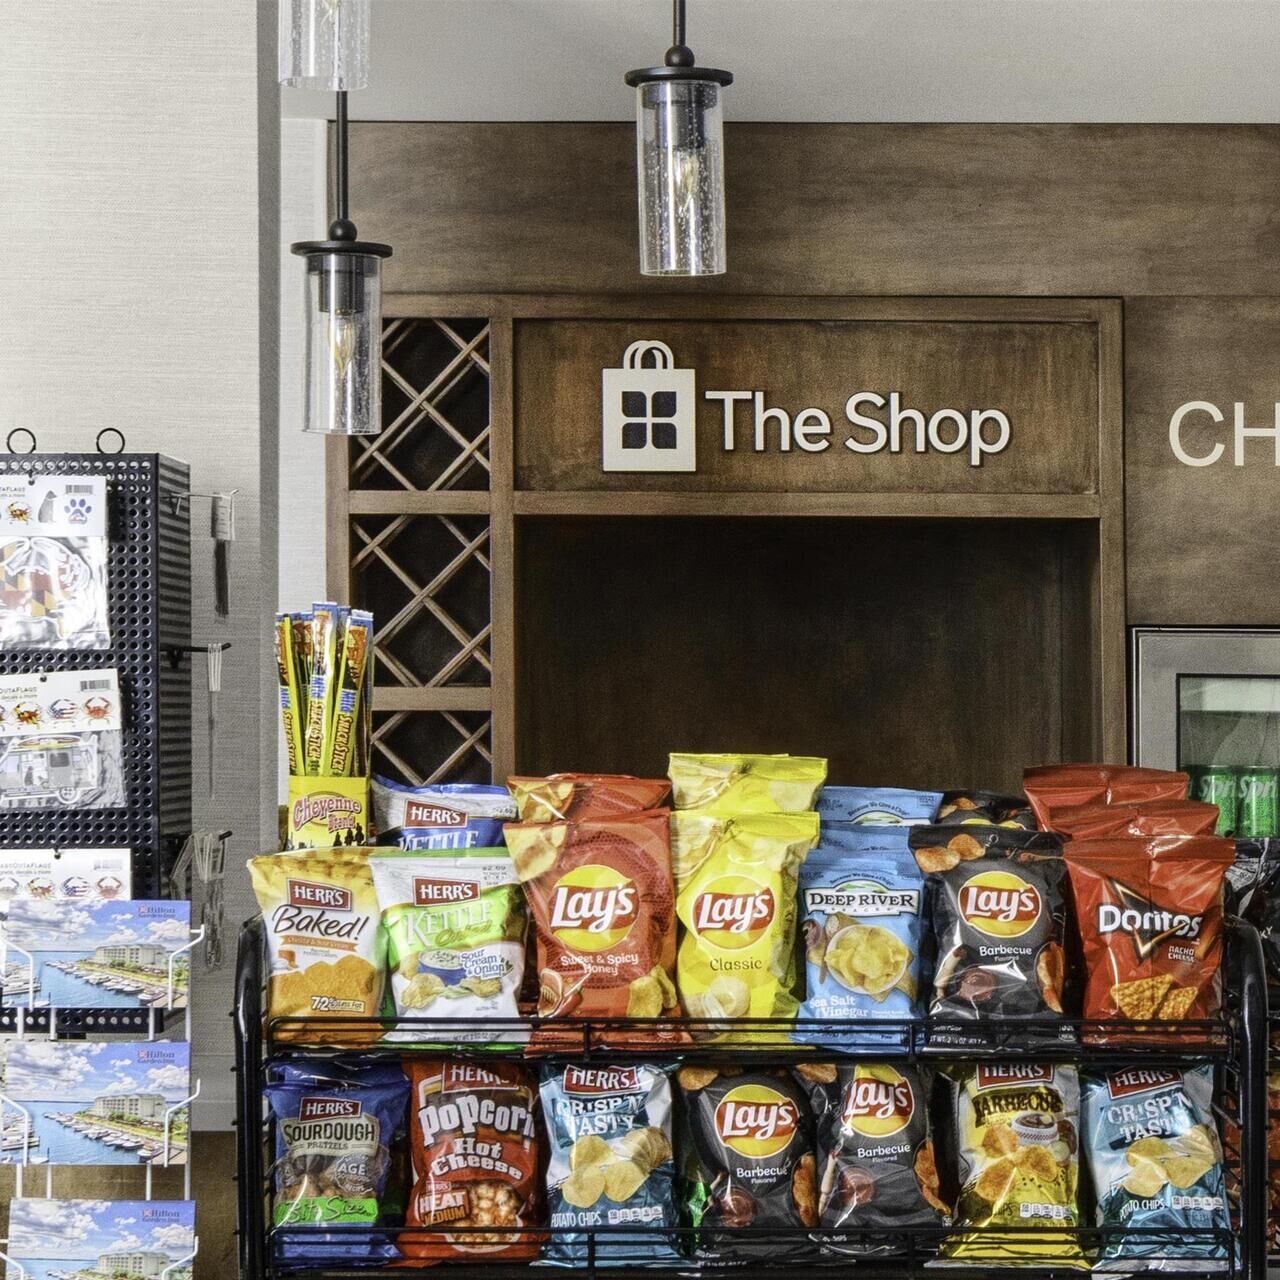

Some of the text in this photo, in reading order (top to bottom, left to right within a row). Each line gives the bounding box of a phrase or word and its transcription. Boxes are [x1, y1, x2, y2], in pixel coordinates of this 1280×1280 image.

[705, 390, 1012, 467] The Shop
[340, 690, 357, 713] Mild
[293, 793, 361, 829] Cheyenne
[411, 806, 461, 825] HERR'S
[293, 884, 344, 906] HERR'S
[420, 884, 474, 904] HERR'S
[809, 893, 915, 907] DEEP RIVER
[551, 883, 636, 933] Lay's
[697, 889, 770, 933] Lay's
[965, 886, 1035, 923] Lay's
[271, 904, 370, 940] Baked!
[405, 900, 493, 946] KETTLE
[1098, 904, 1204, 937] Doritos
[461, 949, 485, 962] Sour
[560, 952, 640, 968] Sweet & Spicy
[979, 945, 1033, 957] Barbecue
[464, 954, 498, 969] Cream
[474, 961, 505, 976] Onion
[584, 963, 619, 977] Honey
[709, 956, 763, 972] Classic
[821, 1004, 869, 1018] Vinegar
[830, 995, 856, 1007] Salt
[570, 1069, 631, 1089] HERR'S
[305, 1101, 354, 1116] HERR'S
[843, 1082, 908, 1119] Lay's
[722, 1098, 793, 1140] Lay's
[283, 1122, 376, 1144] SOURDOUGH
[307, 1142, 349, 1150] PRETZELS
[454, 1137, 502, 1159] Hot
[856, 1144, 911, 1158] Barbecue
[431, 1153, 523, 1181] Cheese
[735, 1164, 790, 1179] Barbecue
[420, 1191, 467, 1212] HEAT
[1141, 1199, 1164, 1211] CHIPS
[577, 1211, 602, 1227] CHIPS
